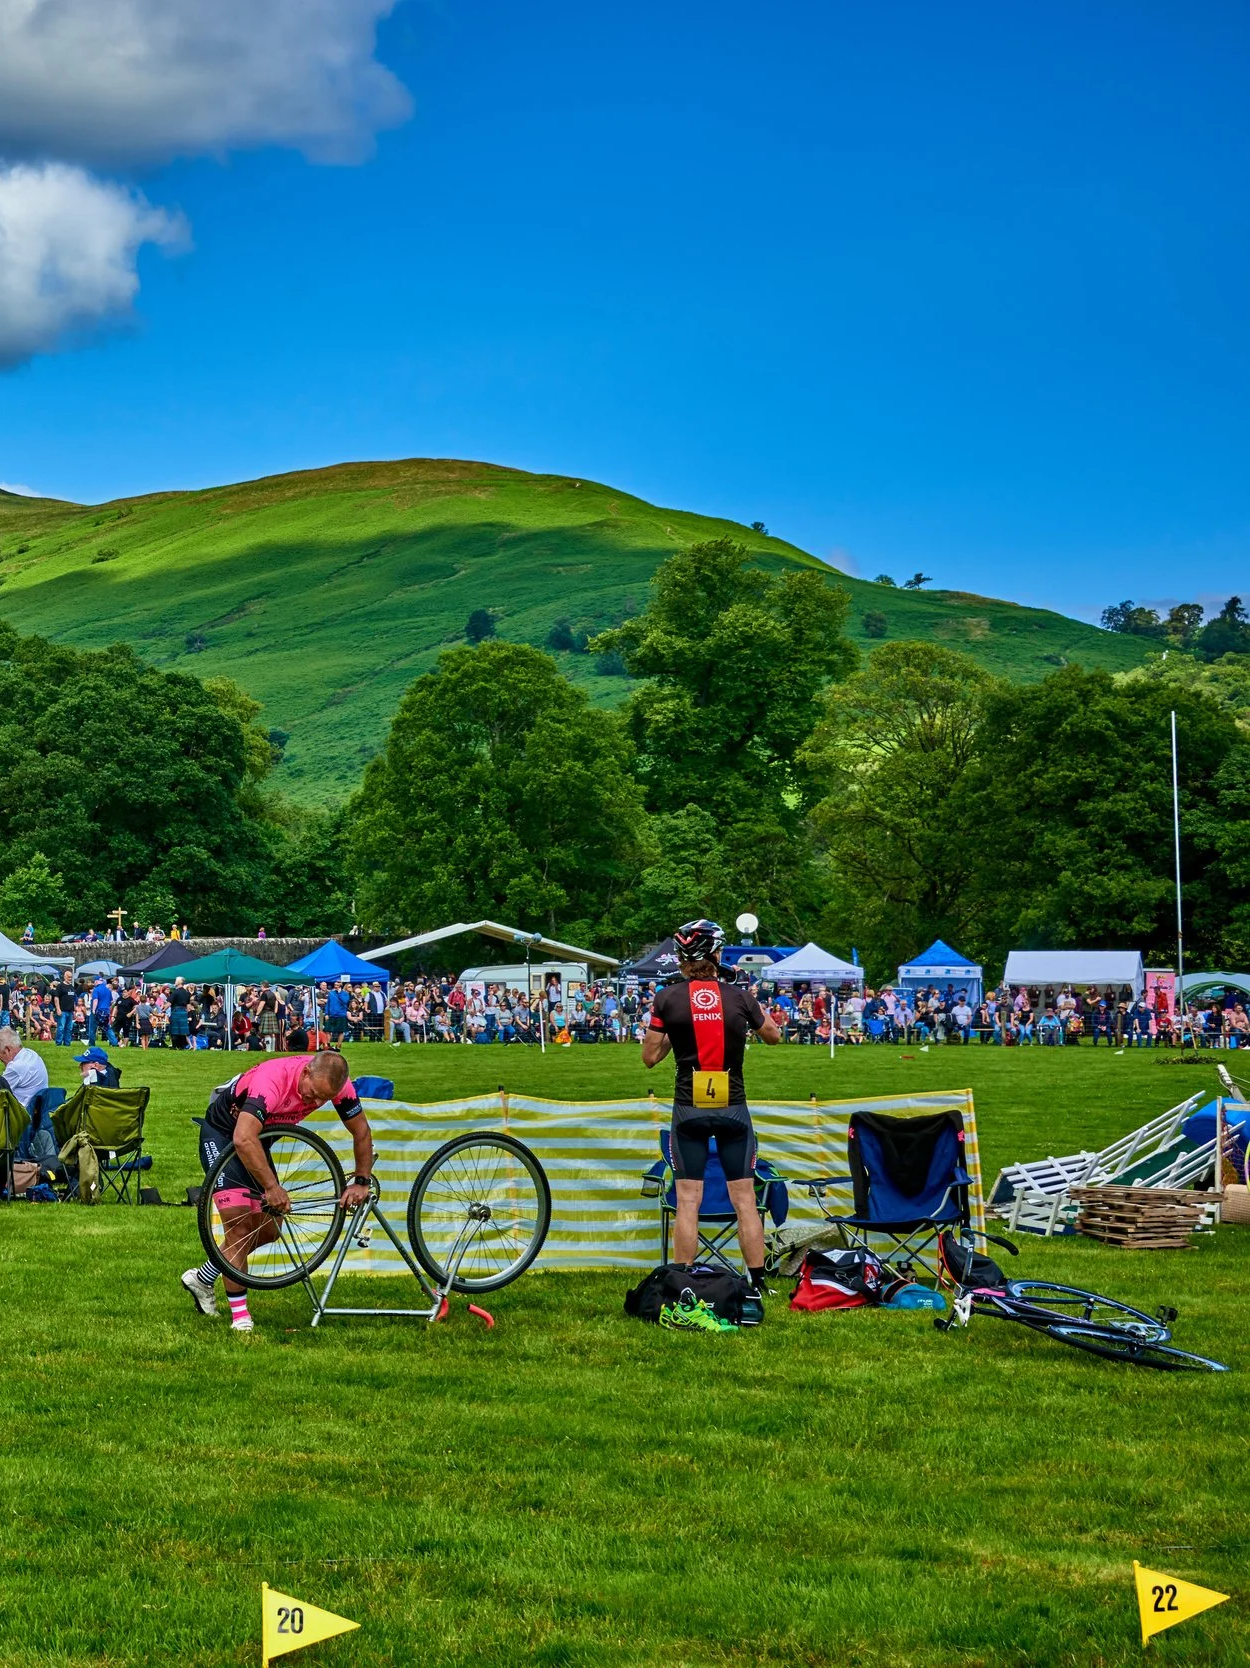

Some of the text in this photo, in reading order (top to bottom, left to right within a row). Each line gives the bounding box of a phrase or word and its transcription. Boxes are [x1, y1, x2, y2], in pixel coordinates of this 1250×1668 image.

[693, 1012, 722, 1021] FENIX
[706, 1078, 716, 1099] 4
[1151, 1584, 1179, 1612] 22
[277, 1607, 304, 1634] 20
